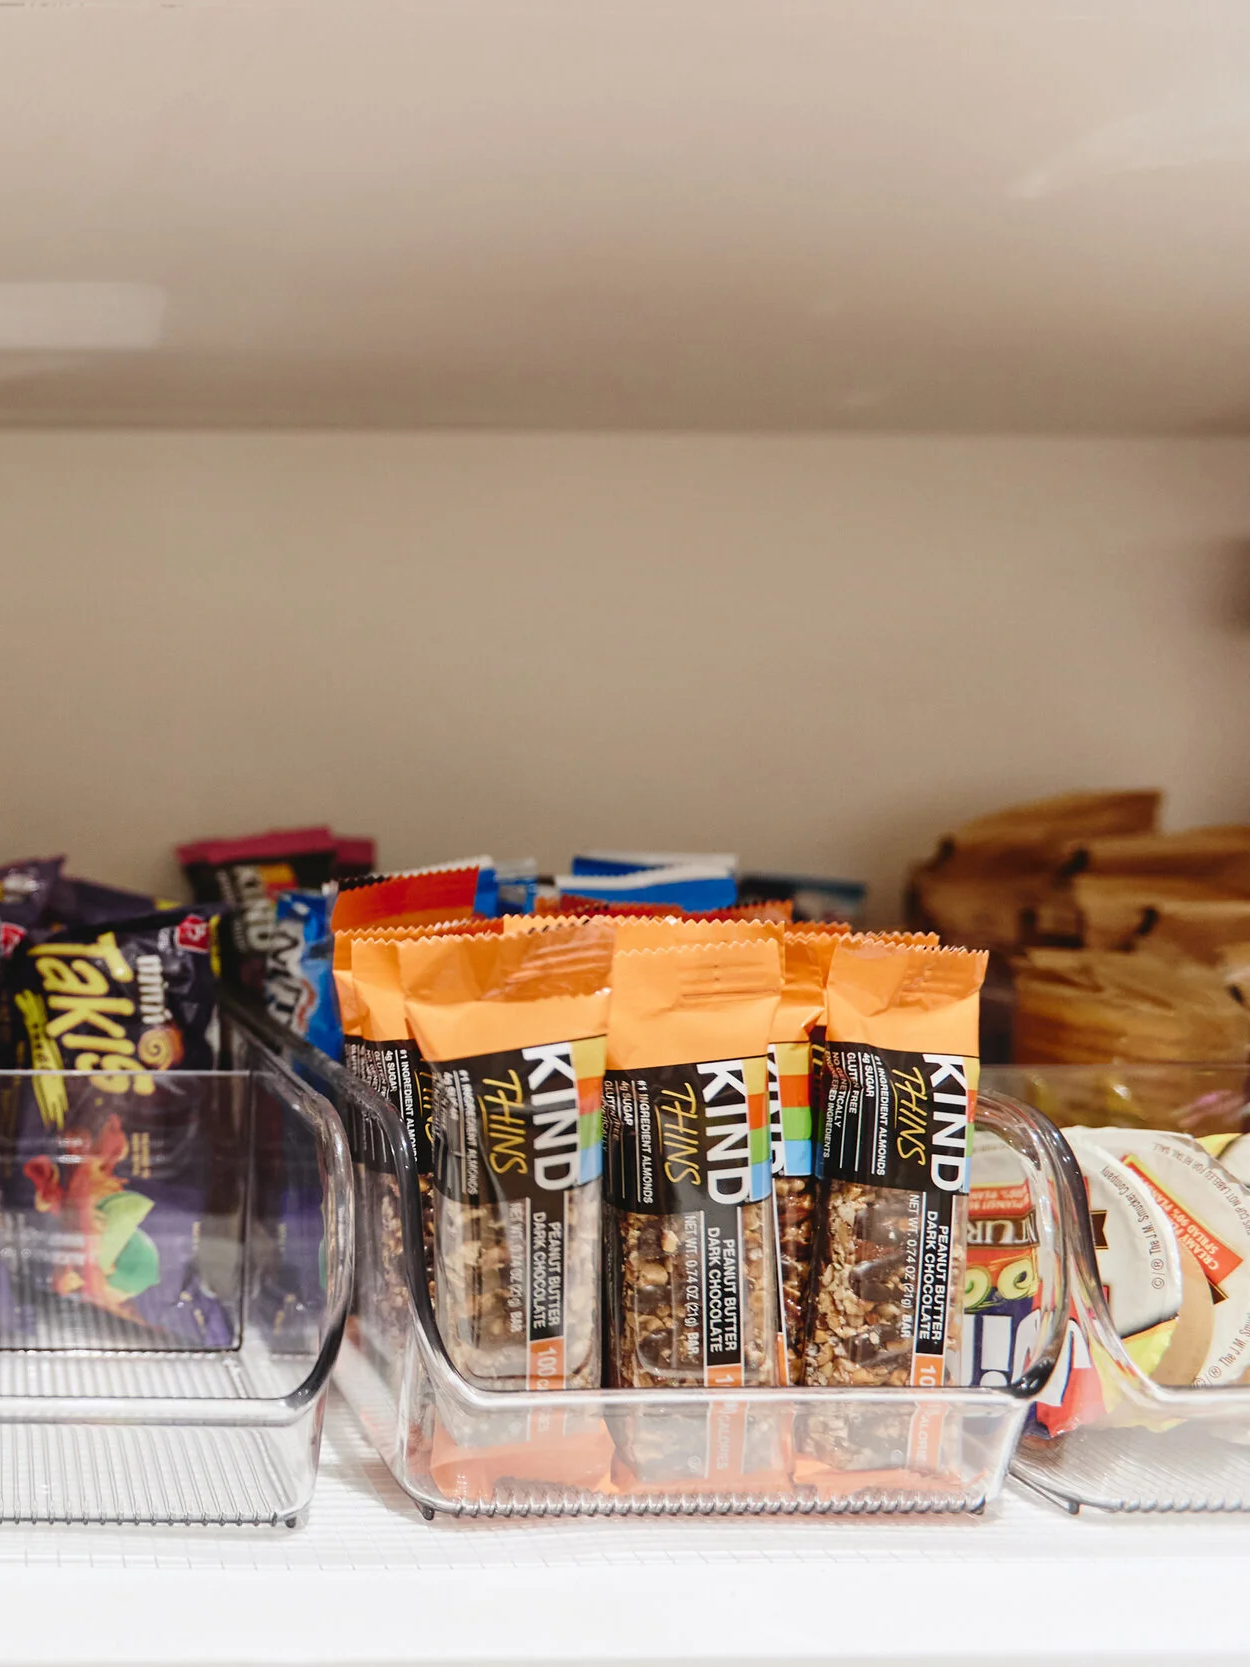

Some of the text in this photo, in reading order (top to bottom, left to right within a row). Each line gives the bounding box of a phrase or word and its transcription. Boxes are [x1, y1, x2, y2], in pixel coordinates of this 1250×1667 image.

[135, 955, 171, 1024] mini
[385, 1051, 397, 1092] 4g SUGAR
[401, 1062, 413, 1116] INGREDIENT
[832, 1052, 847, 1127] NO GENETICALLY
[847, 1052, 860, 1114] GLUTEN FREE
[862, 1053, 874, 1097] 4g SUGAR
[522, 1042, 578, 1191] KIND
[877, 1068, 888, 1125] INGREDIENT
[892, 1067, 927, 1165] THINS
[482, 1070, 528, 1174] THINS
[637, 1080, 653, 1203] #1 INGREDIENT ALMONDS
[661, 1083, 701, 1185] THINS
[697, 1061, 750, 1204] KIND
[823, 1103, 835, 1158] INGREDIENTS
[922, 1054, 967, 1191] KIND
[467, 1149, 478, 1195] ALMONDS
[877, 1127, 887, 1175] ALMONDS
[908, 1194, 920, 1214] NET
[1102, 1166, 1130, 1195] Company
[1226, 1193, 1242, 1207] NOT
[684, 1216, 697, 1237] NET
[1126, 1192, 1150, 1223] Smucker
[906, 1239, 917, 1264] 0.74
[1150, 1240, 1162, 1255] The
[1178, 1234, 1219, 1270] CREAMY
[1187, 1224, 1219, 1254] SPREAD
[533, 1212, 546, 1328] DARK CHOCOLATE
[547, 1222, 561, 1326] PEANUT BUTTER
[685, 1260, 699, 1283] 0.74
[686, 1285, 698, 1300] OZ
[708, 1227, 722, 1352] DARK CHOCOLATE
[904, 1267, 915, 1280] OZ
[919, 1211, 937, 1340] DARK CHOCOLATE
[932, 1225, 949, 1341] PEANUT BUTTER
[684, 1303, 699, 1327] (21g)
[723, 1240, 737, 1351] PEANUT BUTTER
[901, 1283, 914, 1308] (21g)
[901, 1314, 912, 1337] BAR
[538, 1348, 557, 1375] 100
[920, 1365, 936, 1386] 10
[1218, 1353, 1237, 1367] The
[916, 1413, 932, 1467] ALORIE
